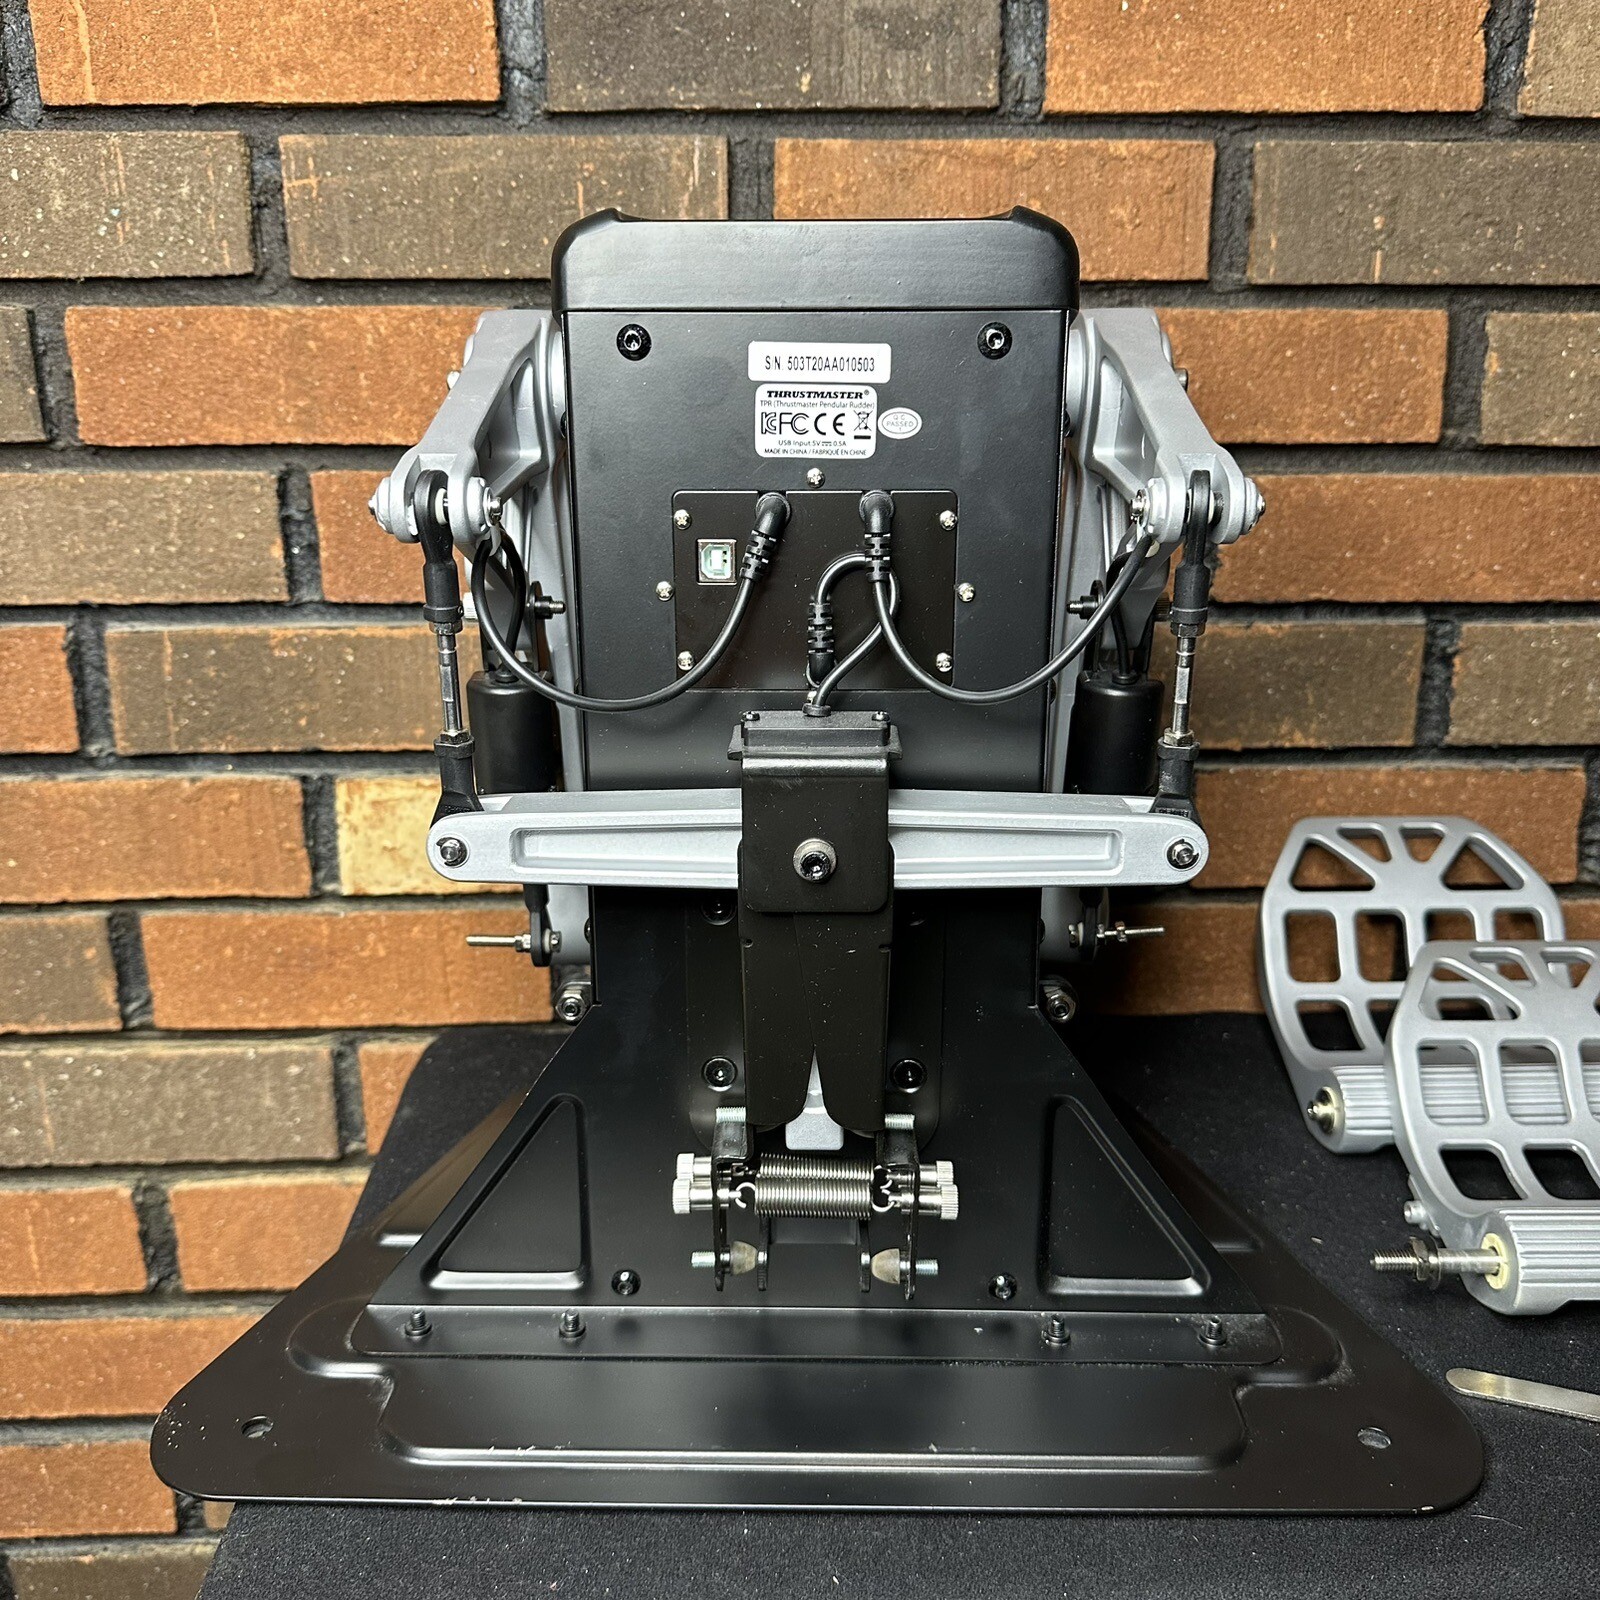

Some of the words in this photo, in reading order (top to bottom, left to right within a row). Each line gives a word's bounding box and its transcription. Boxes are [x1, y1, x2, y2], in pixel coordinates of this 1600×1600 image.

[787, 356, 875, 372] 503T20AA010503
[760, 400, 773, 408] TPR
[819, 401, 848, 409] Pendular
[778, 439, 792, 447] USB
[764, 447, 781, 455] MADE
[849, 449, 867, 457] CHINE
